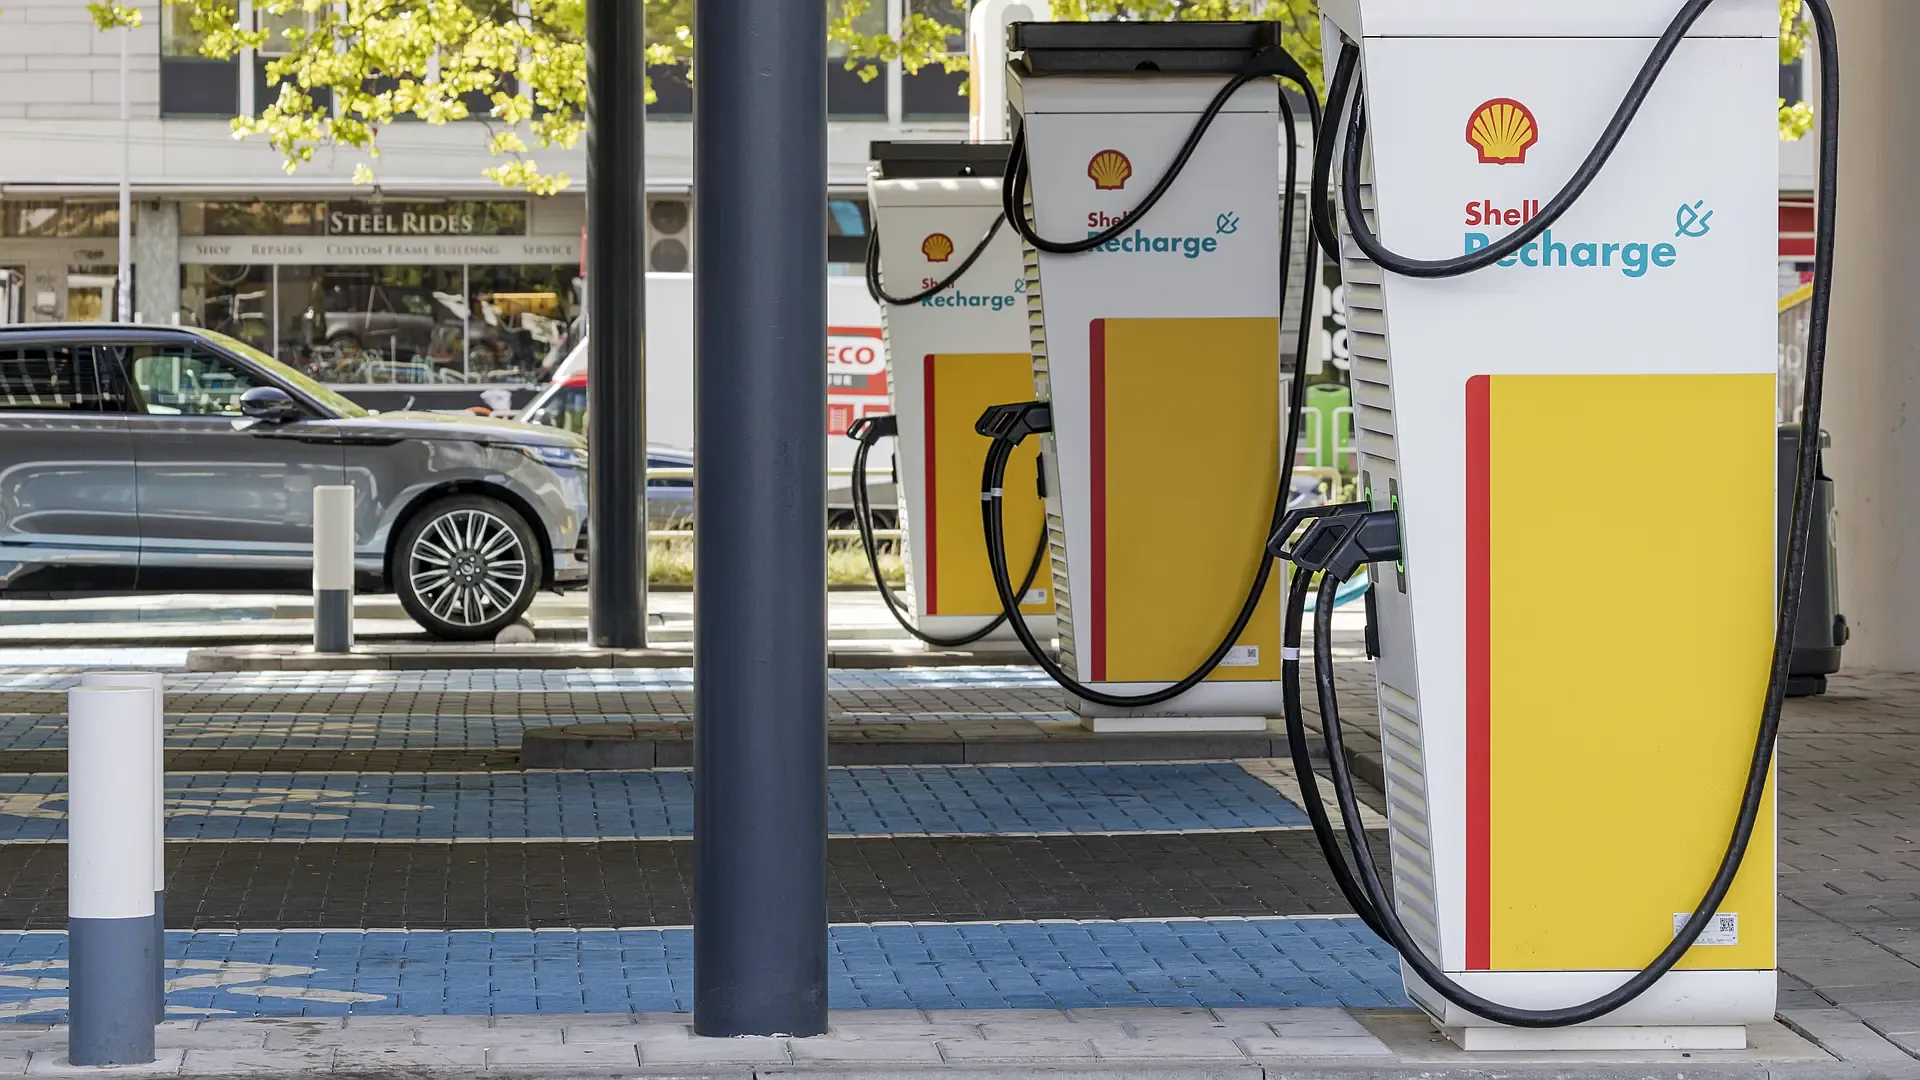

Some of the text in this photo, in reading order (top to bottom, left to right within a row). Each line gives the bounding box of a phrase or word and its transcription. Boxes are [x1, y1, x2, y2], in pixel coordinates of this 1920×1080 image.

[1088, 211, 1131, 227] She
[1465, 200, 1539, 226] Shell
[331, 211, 473, 234] STEEL RIDES
[326, 243, 382, 256] CUSTOM
[388, 243, 429, 256] FRAME
[434, 243, 500, 256] BUILDING
[922, 277, 955, 290] Shl
